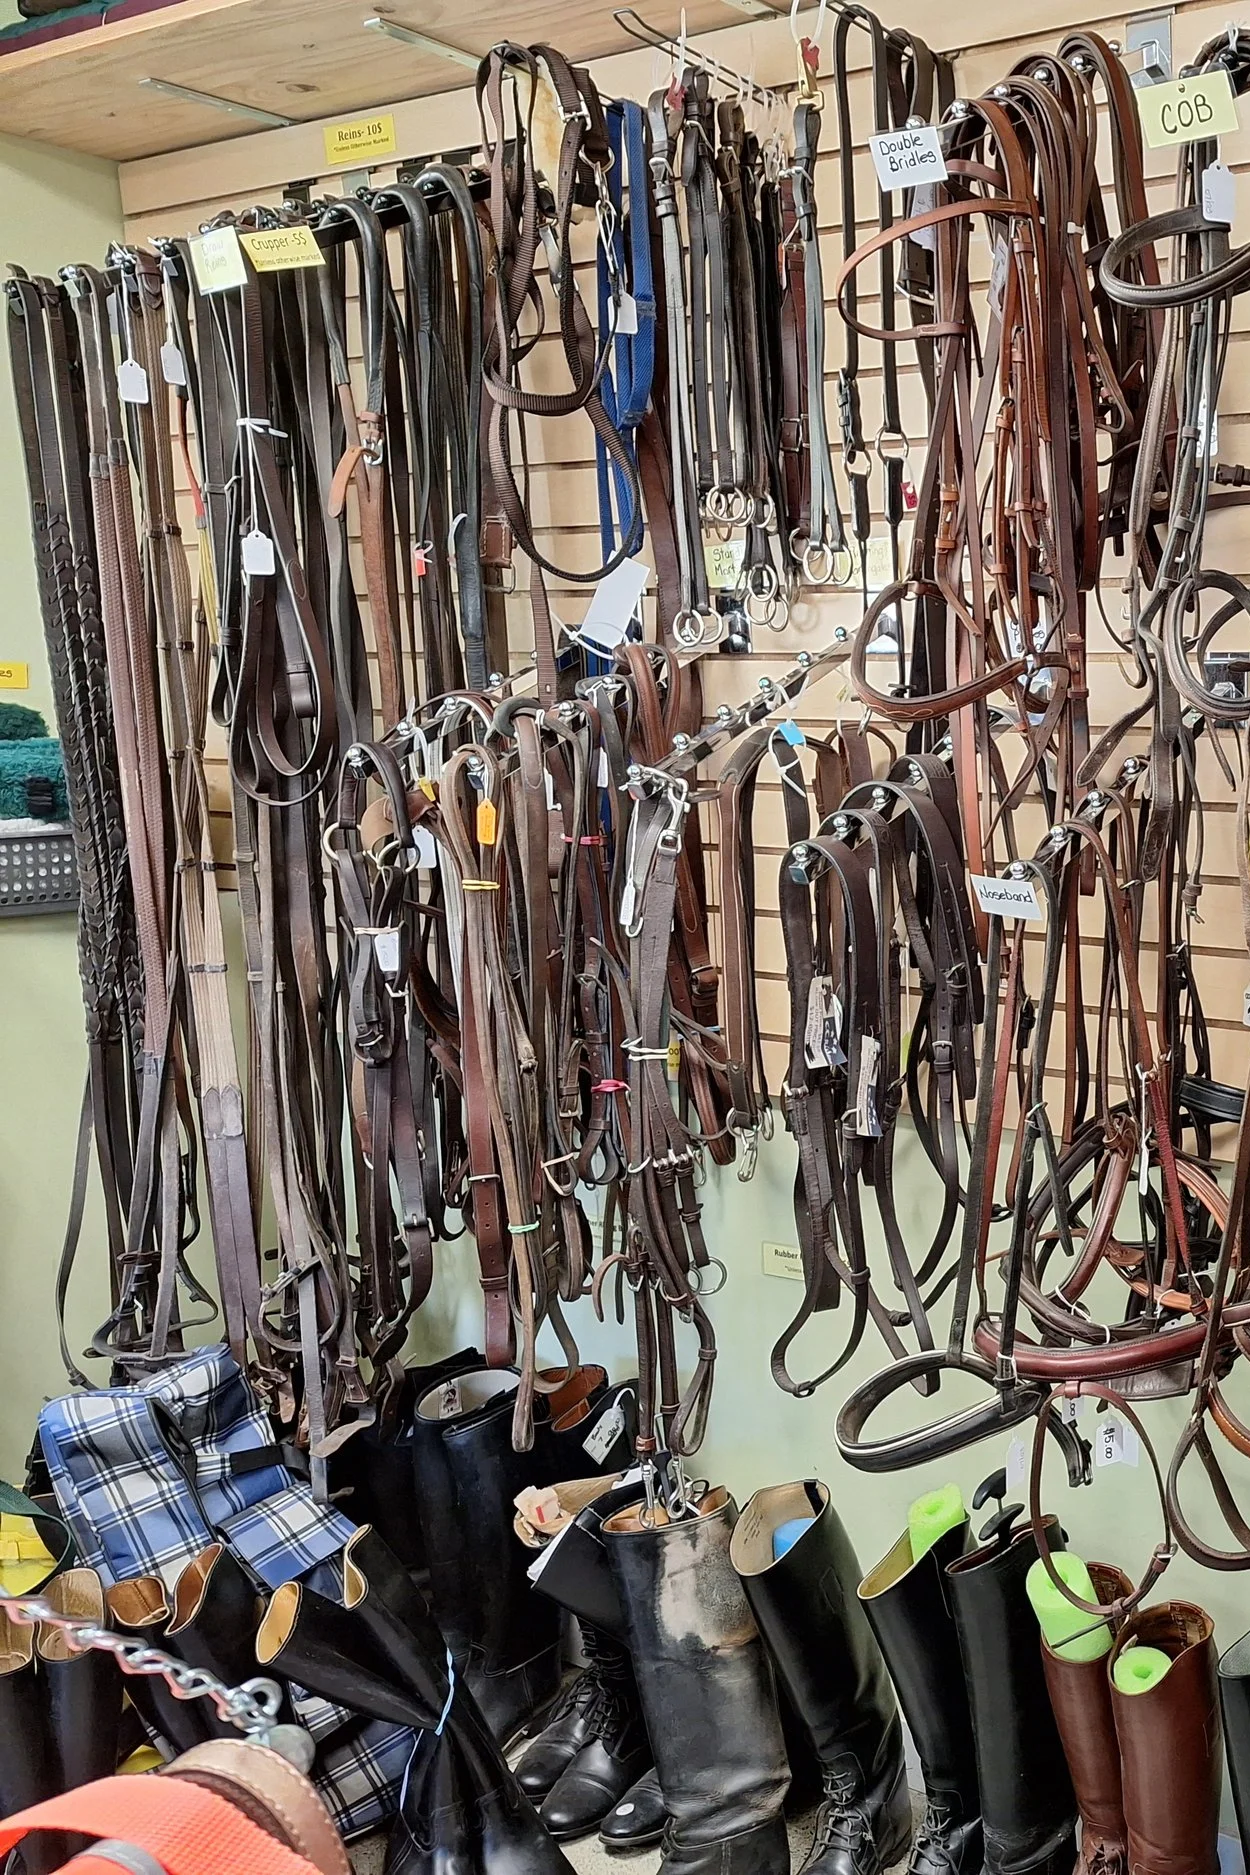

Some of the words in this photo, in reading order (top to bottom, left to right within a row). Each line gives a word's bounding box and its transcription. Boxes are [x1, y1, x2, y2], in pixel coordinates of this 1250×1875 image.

[1161, 93, 1213, 134] COB
[337, 128, 365, 142] Reins-
[879, 132, 924, 156] Double
[888, 150, 937, 172] Bridles
[250, 236, 289, 252] Crupper
[979, 883, 1034, 904] Noseband
[774, 1248, 799, 1260] Rubber
[1102, 1427, 1116, 1459] $5.00
